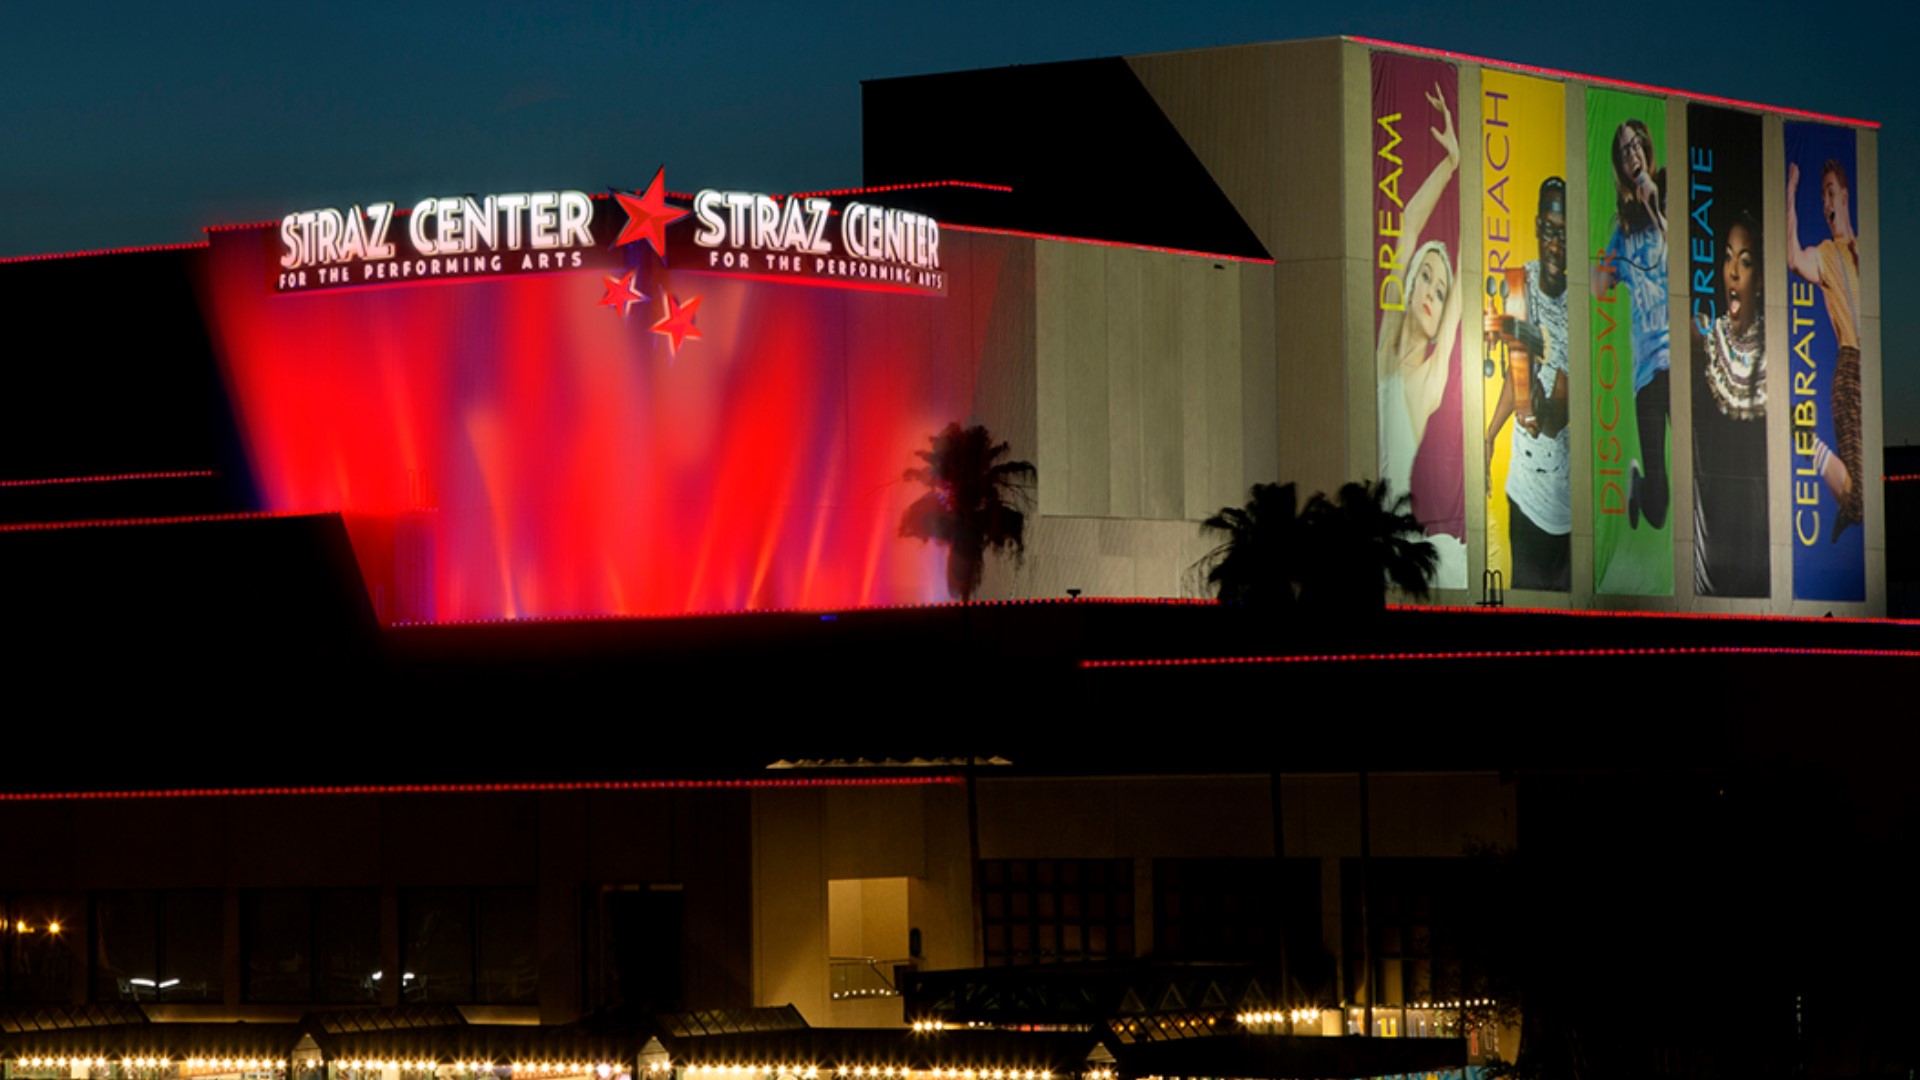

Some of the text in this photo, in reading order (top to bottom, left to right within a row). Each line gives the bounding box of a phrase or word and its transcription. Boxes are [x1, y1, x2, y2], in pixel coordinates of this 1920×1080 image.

[278, 251, 583, 289] FOR THE PERFORMING ARTS
[280, 190, 595, 269] STRAZ CENTER
[693, 188, 941, 270] STRAZ CENTER
[709, 251, 943, 290] FOR THE PERFORMING ARTS
[1377, 112, 1405, 311] DREAM
[1484, 91, 1511, 274] REACH
[1691, 146, 1716, 336] CREATE
[1596, 247, 1626, 515] DISCOVER
[1791, 282, 1820, 546] CELEBRATE
